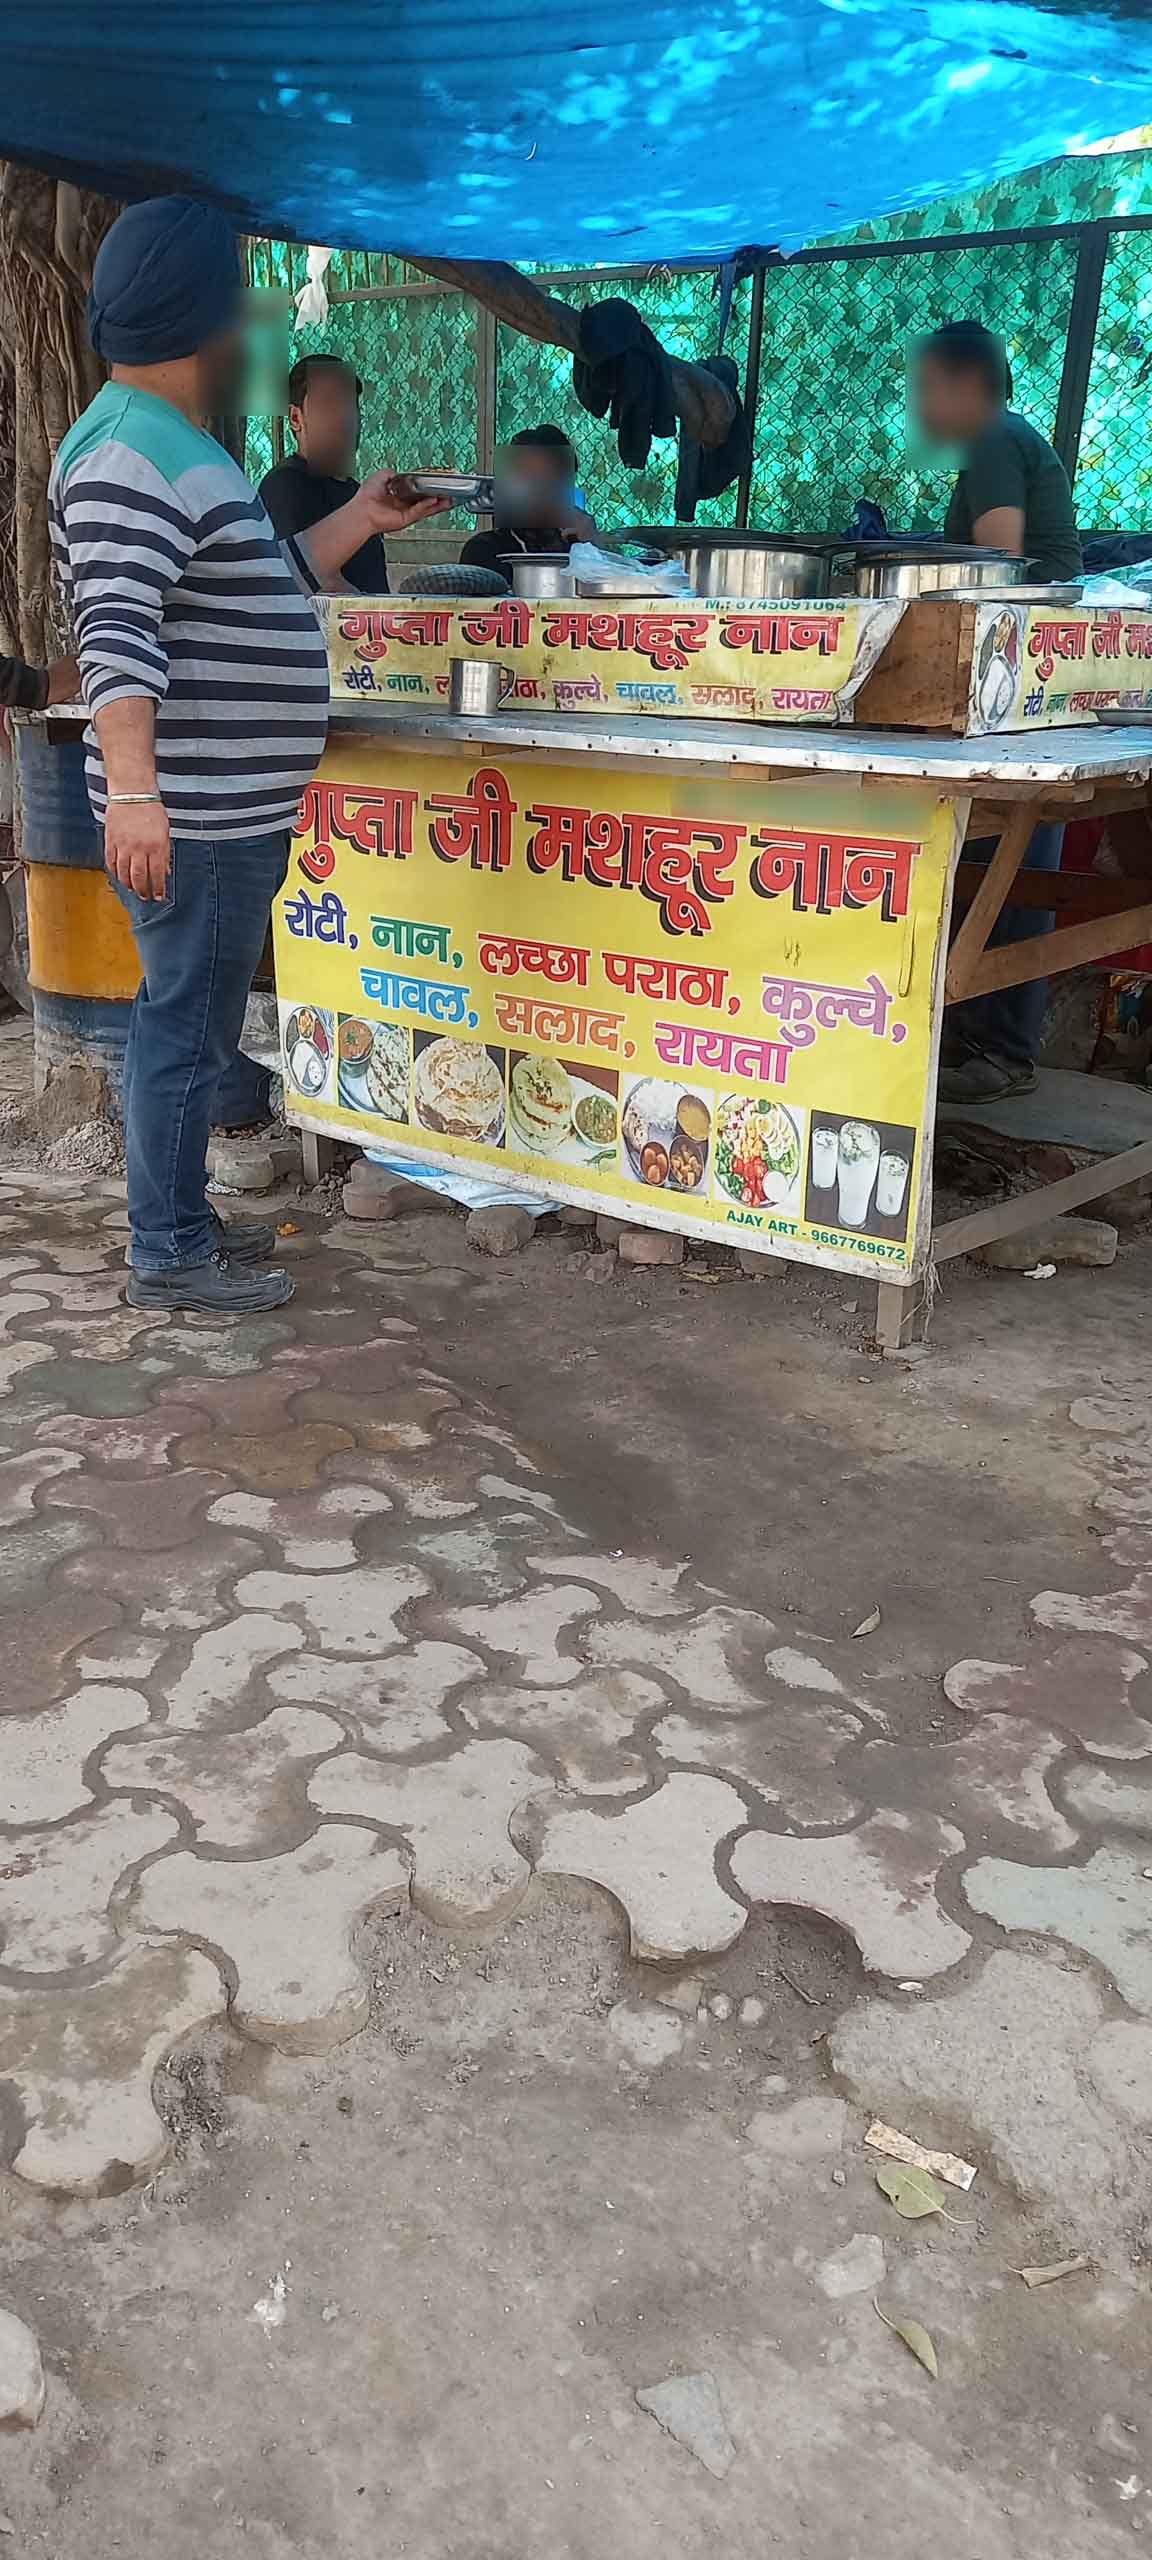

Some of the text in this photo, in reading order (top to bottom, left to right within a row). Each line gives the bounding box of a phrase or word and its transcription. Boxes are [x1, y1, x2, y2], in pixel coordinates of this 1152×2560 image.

[338, 600, 845, 670] गुप्ता जी मशहूर नान
[1028, 622, 1089, 681] गुप्ता
[1091, 611, 1123, 659] जी
[341, 665, 382, 693] रोटी,
[386, 673, 430, 696] नान,
[771, 688, 833, 710] रायता
[291, 767, 923, 936] गुप्ता जी मशहूर नान
[283, 889, 908, 1048] रोटी, नान, लच्छा पराठा, कुल्चे,
[360, 968, 794, 1084] चावल, सलाद, रायता
[726, 1209, 764, 1228] AJAY
[767, 1219, 799, 1236] ART
[810, 1228, 907, 1262] 9667769672
